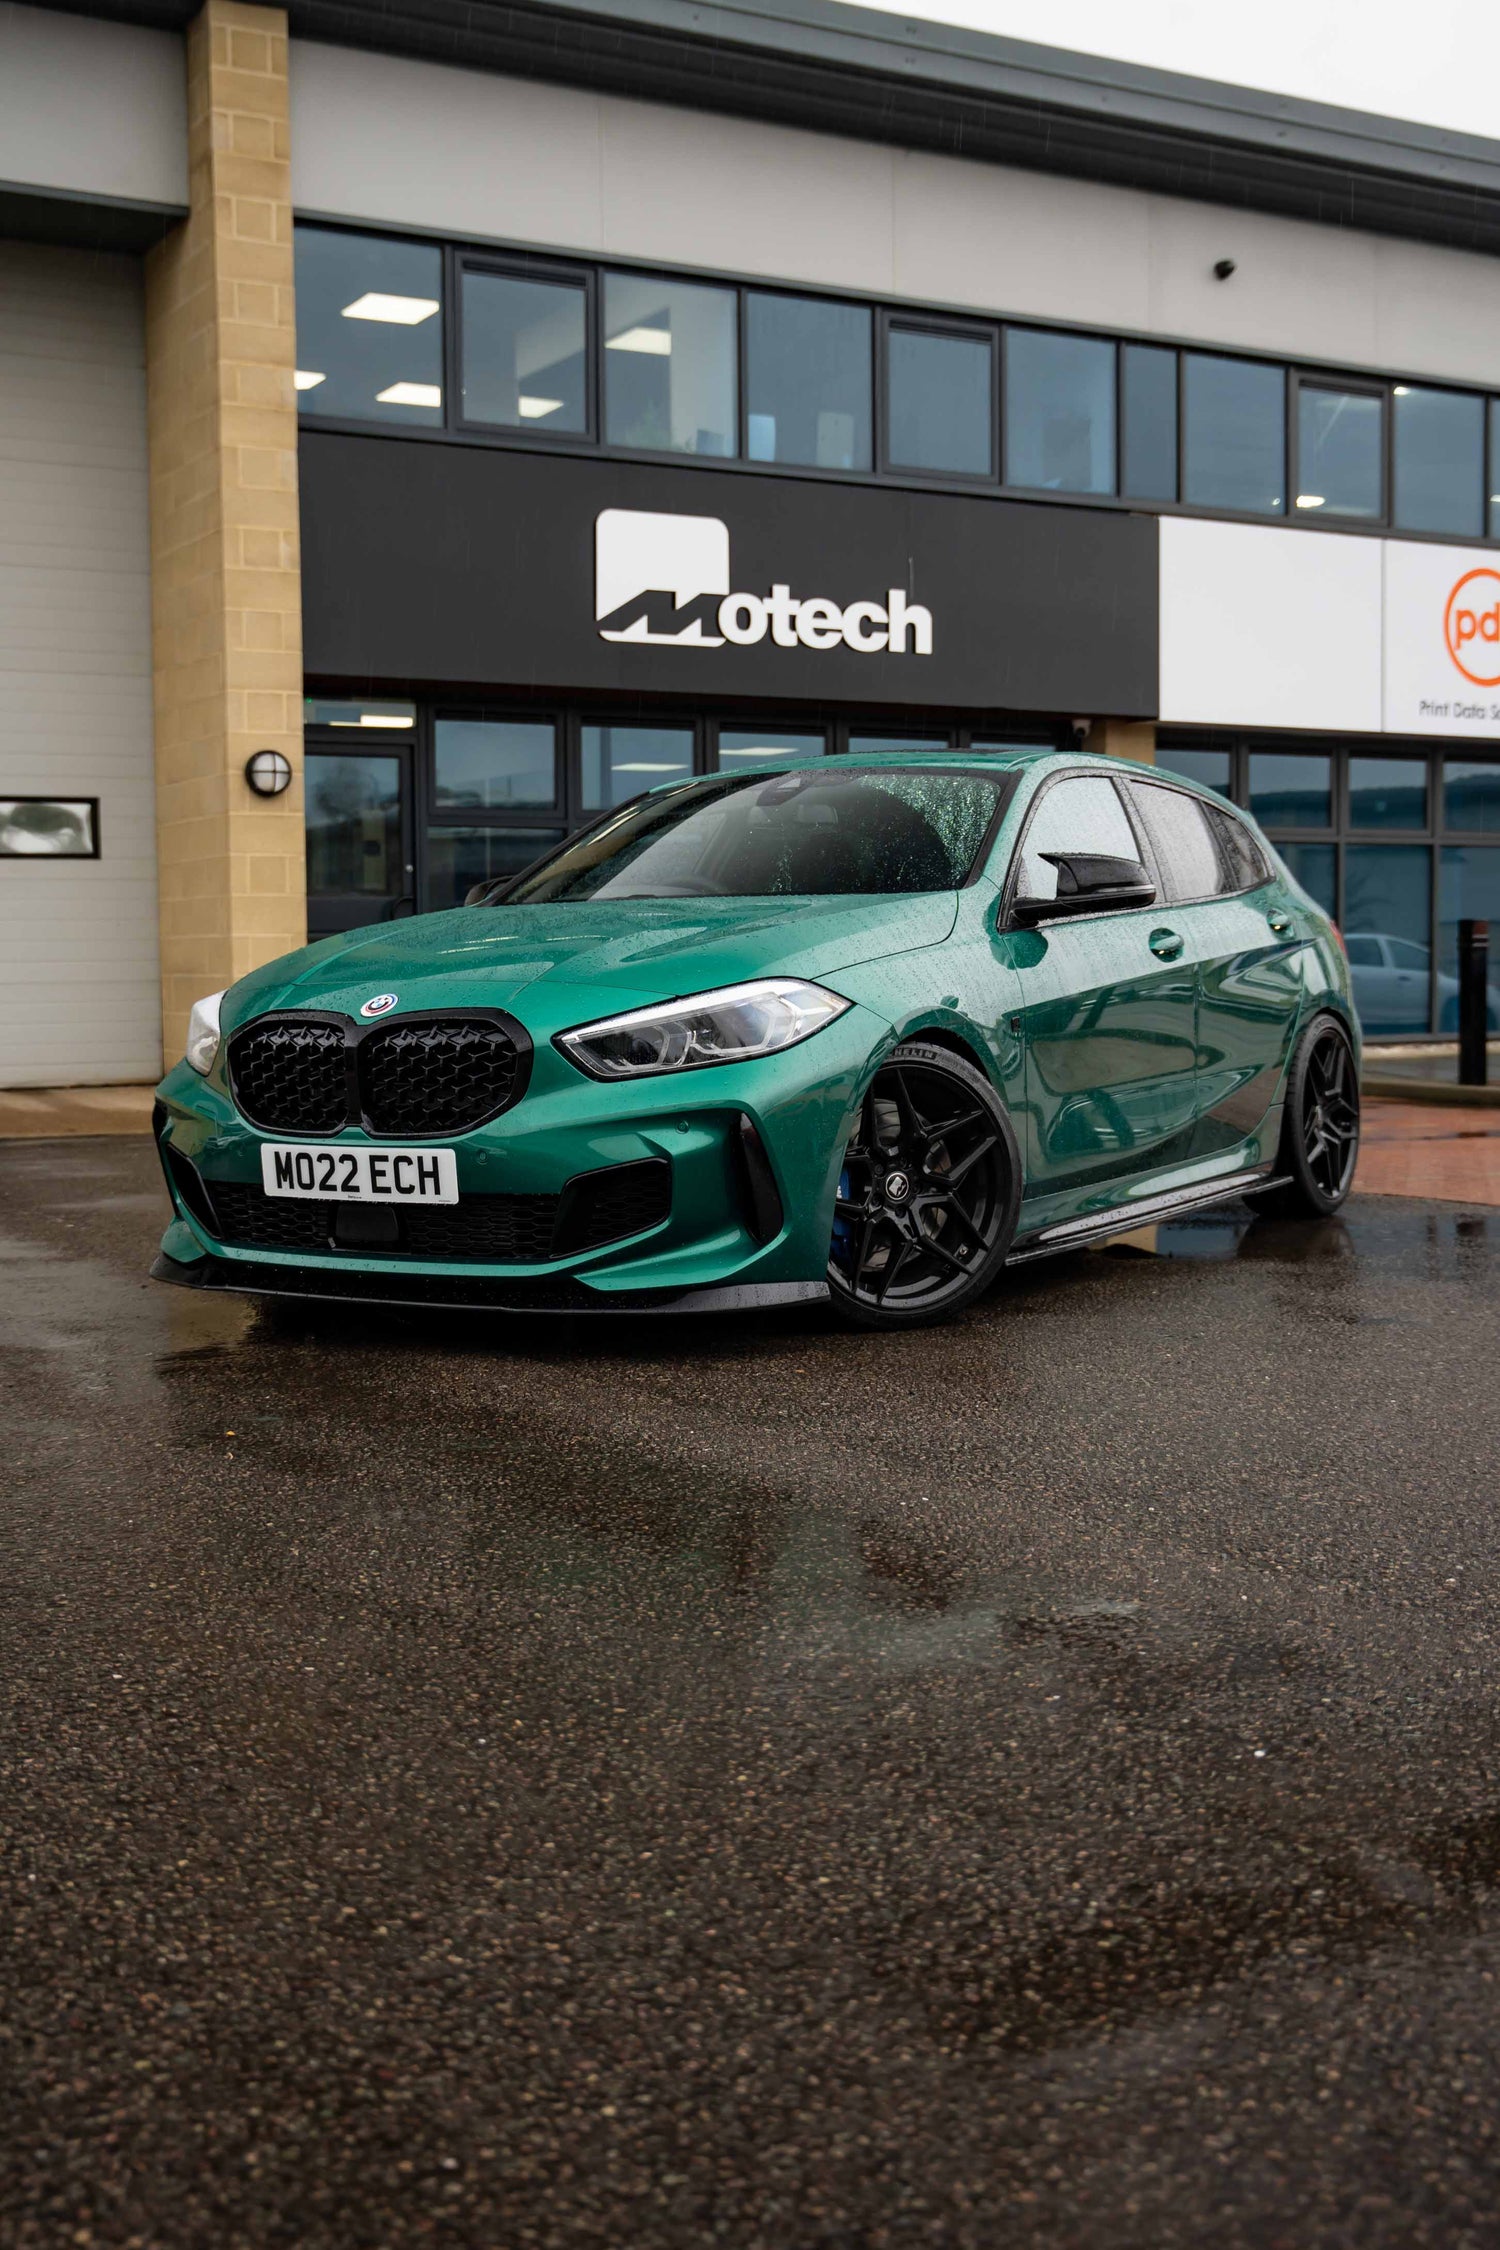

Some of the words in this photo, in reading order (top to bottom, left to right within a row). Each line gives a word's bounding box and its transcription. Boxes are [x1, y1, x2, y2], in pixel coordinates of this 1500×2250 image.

[597, 580, 933, 655] Motech
[1419, 700, 1448, 717] Print
[1453, 702, 1485, 720] Data
[274, 1151, 360, 1193] MO22
[369, 1155, 441, 1196] ECH
